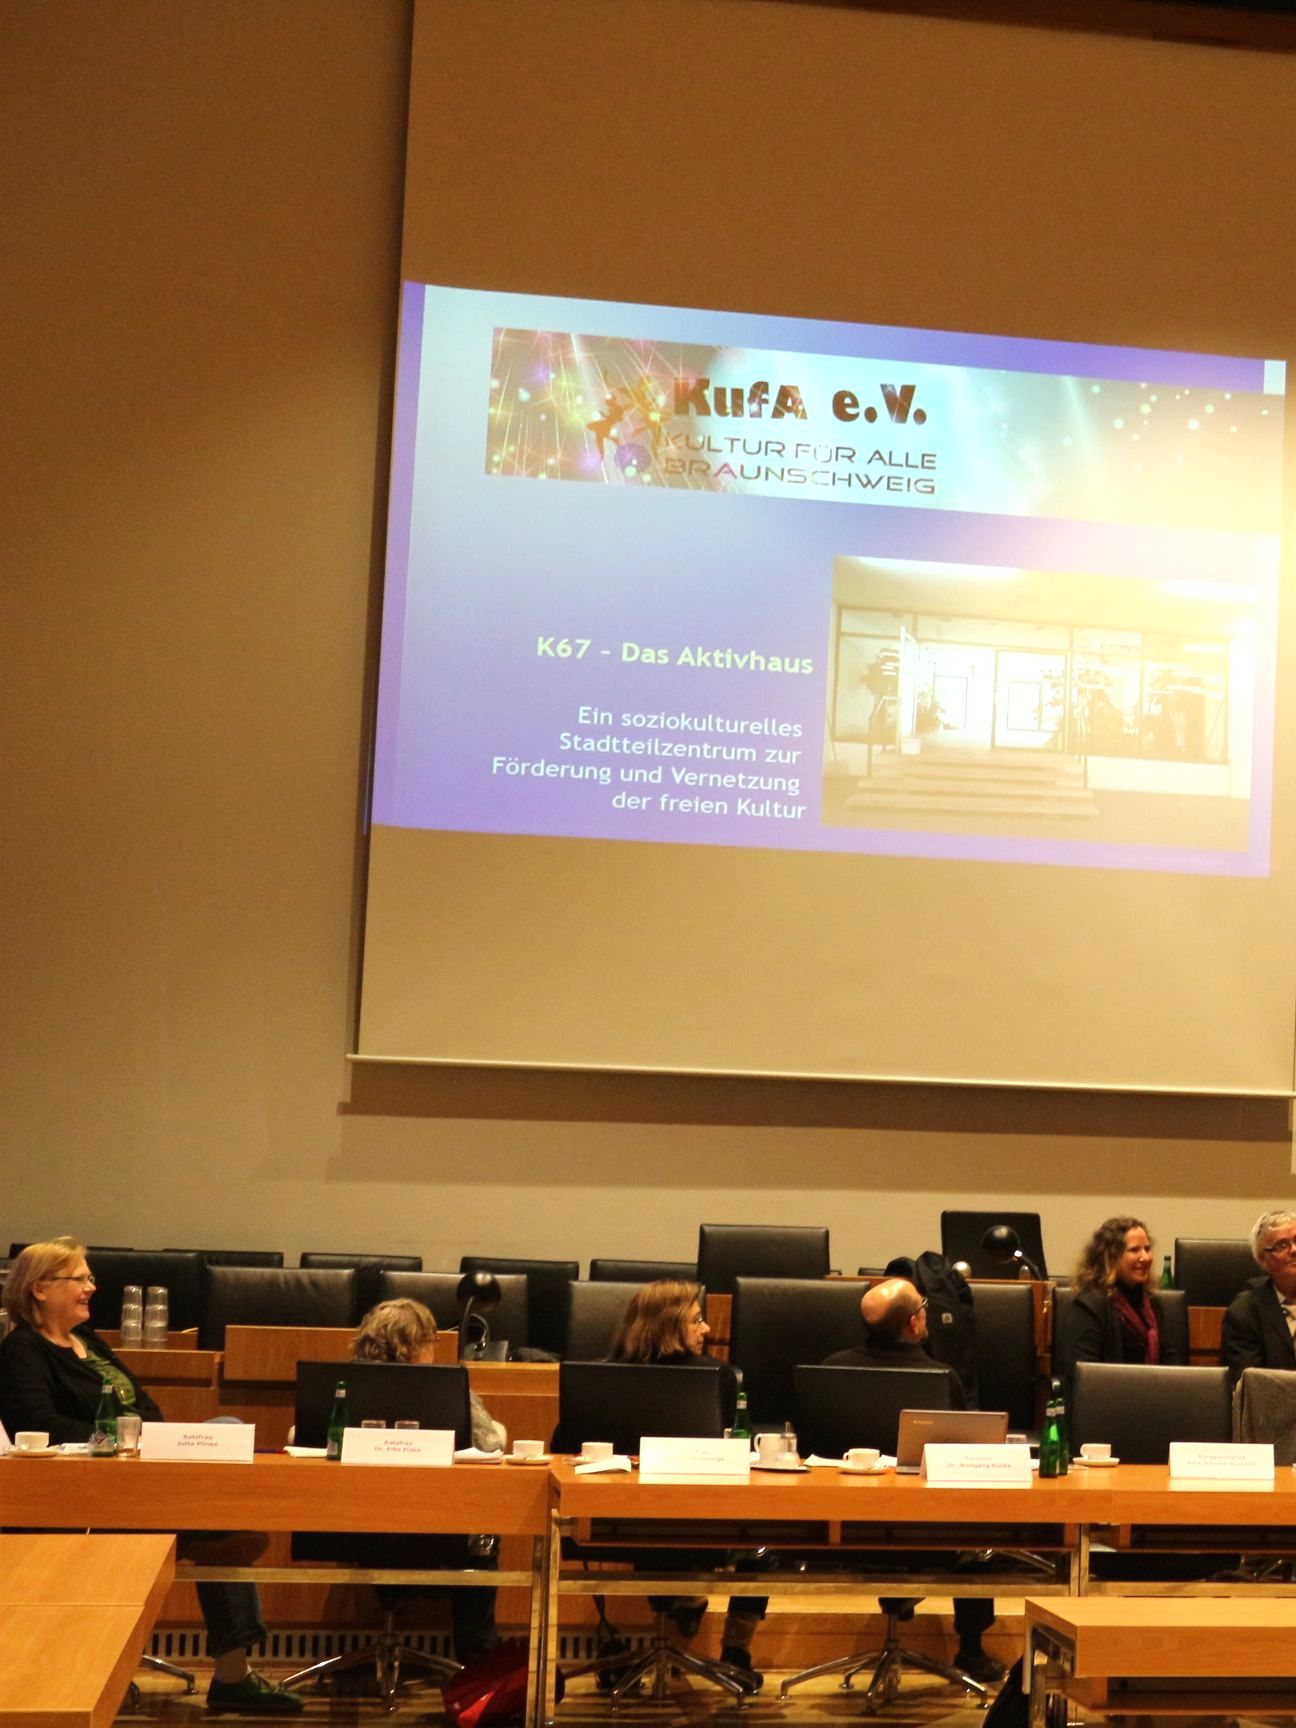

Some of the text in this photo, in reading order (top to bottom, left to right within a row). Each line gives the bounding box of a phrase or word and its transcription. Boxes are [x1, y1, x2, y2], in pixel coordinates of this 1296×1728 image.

[673, 377, 928, 425] KufA e.V.
[665, 431, 937, 470] KULTUR FÜR ALLE
[664, 458, 936, 494] BRAUNSCHWEIG
[536, 636, 592, 659] K67
[621, 642, 670, 665] Das
[677, 646, 814, 674] Aktivhaus
[578, 706, 803, 737] Ein soziokulturelles
[559, 732, 802, 764] Stadtteilzentrum zur
[492, 756, 801, 796] Förderung und Vernetzung
[612, 791, 807, 819] der freien Kultur
